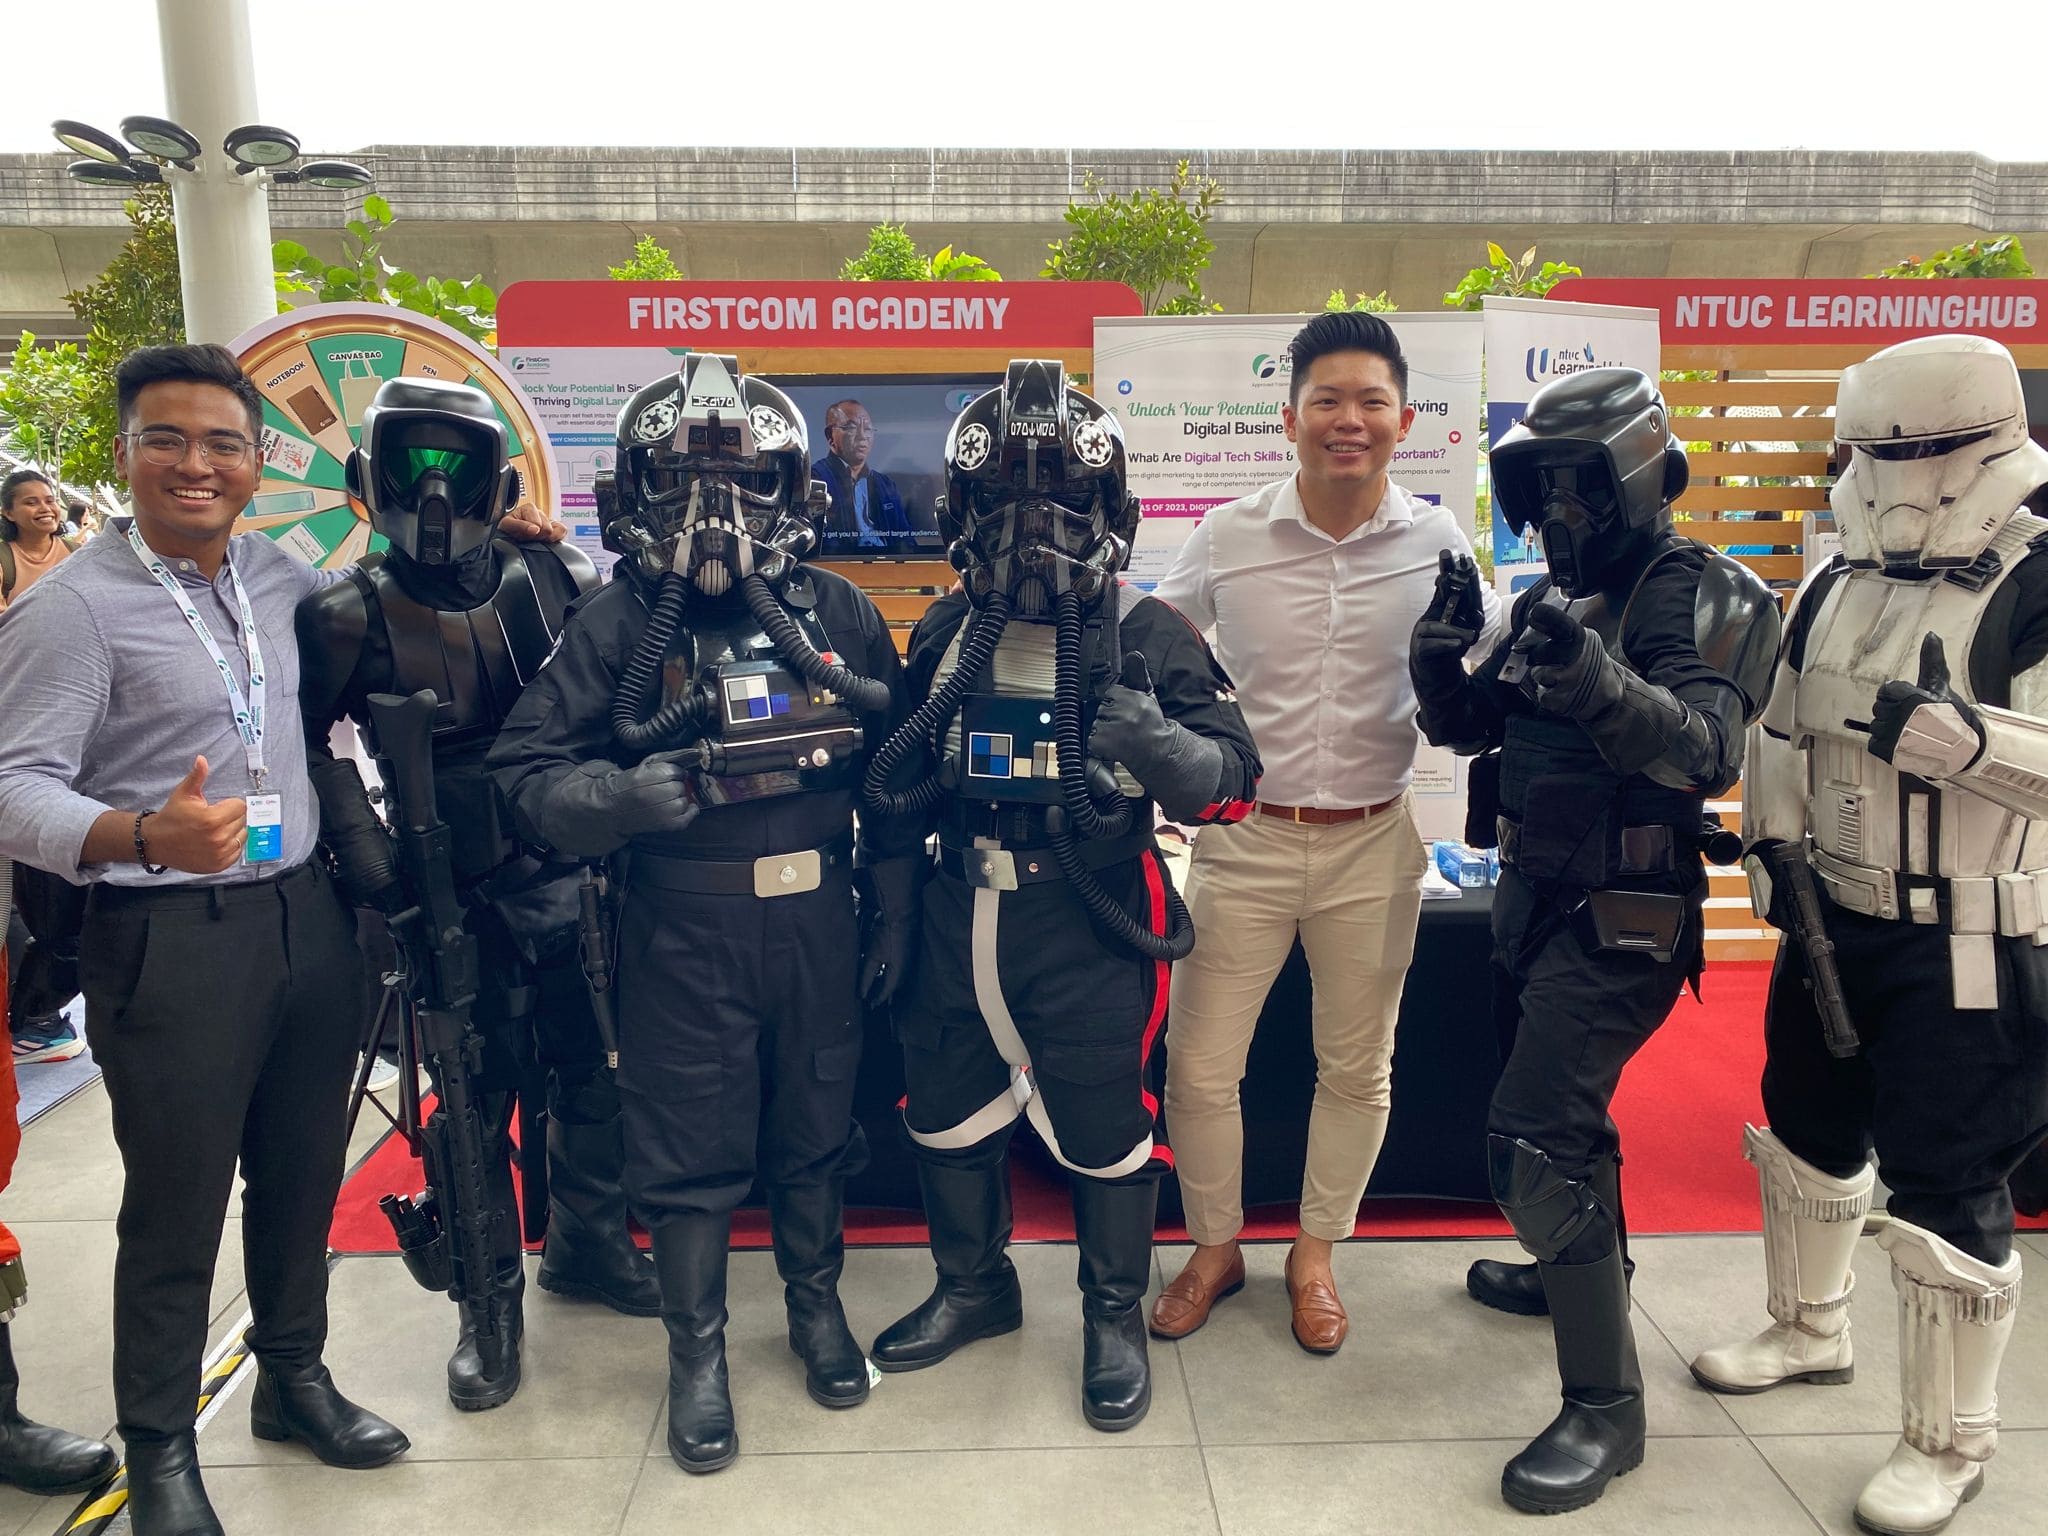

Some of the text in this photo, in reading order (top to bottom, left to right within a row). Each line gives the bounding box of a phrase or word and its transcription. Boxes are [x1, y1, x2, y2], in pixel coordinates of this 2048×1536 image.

[628, 296, 1010, 331] FIRSTCOM ACADEMY
[1675, 295, 2038, 328] NTUC LEARNINGHUB
[328, 351, 382, 361] CANVAS BAG
[422, 364, 438, 376] PEN
[1280, 364, 1292, 372] Ac
[266, 361, 307, 389] NOTEBOOK
[521, 384, 544, 392] lock
[547, 384, 568, 392] Your
[570, 384, 614, 392] Potential
[616, 384, 625, 392] In
[532, 397, 571, 408] Thriving
[573, 397, 604, 408] Digital
[1127, 401, 1280, 417] Unlock Your Potential
[1183, 421, 1284, 438] Digital Busine
[1128, 451, 1293, 465] What Are Digital Tech Skills &
[1393, 448, 1446, 462] portant?
[1140, 472, 1161, 480] digital
[1162, 472, 1195, 480] marketing
[1389, 468, 1427, 476] encompass
[1165, 504, 1188, 512] 2023,
